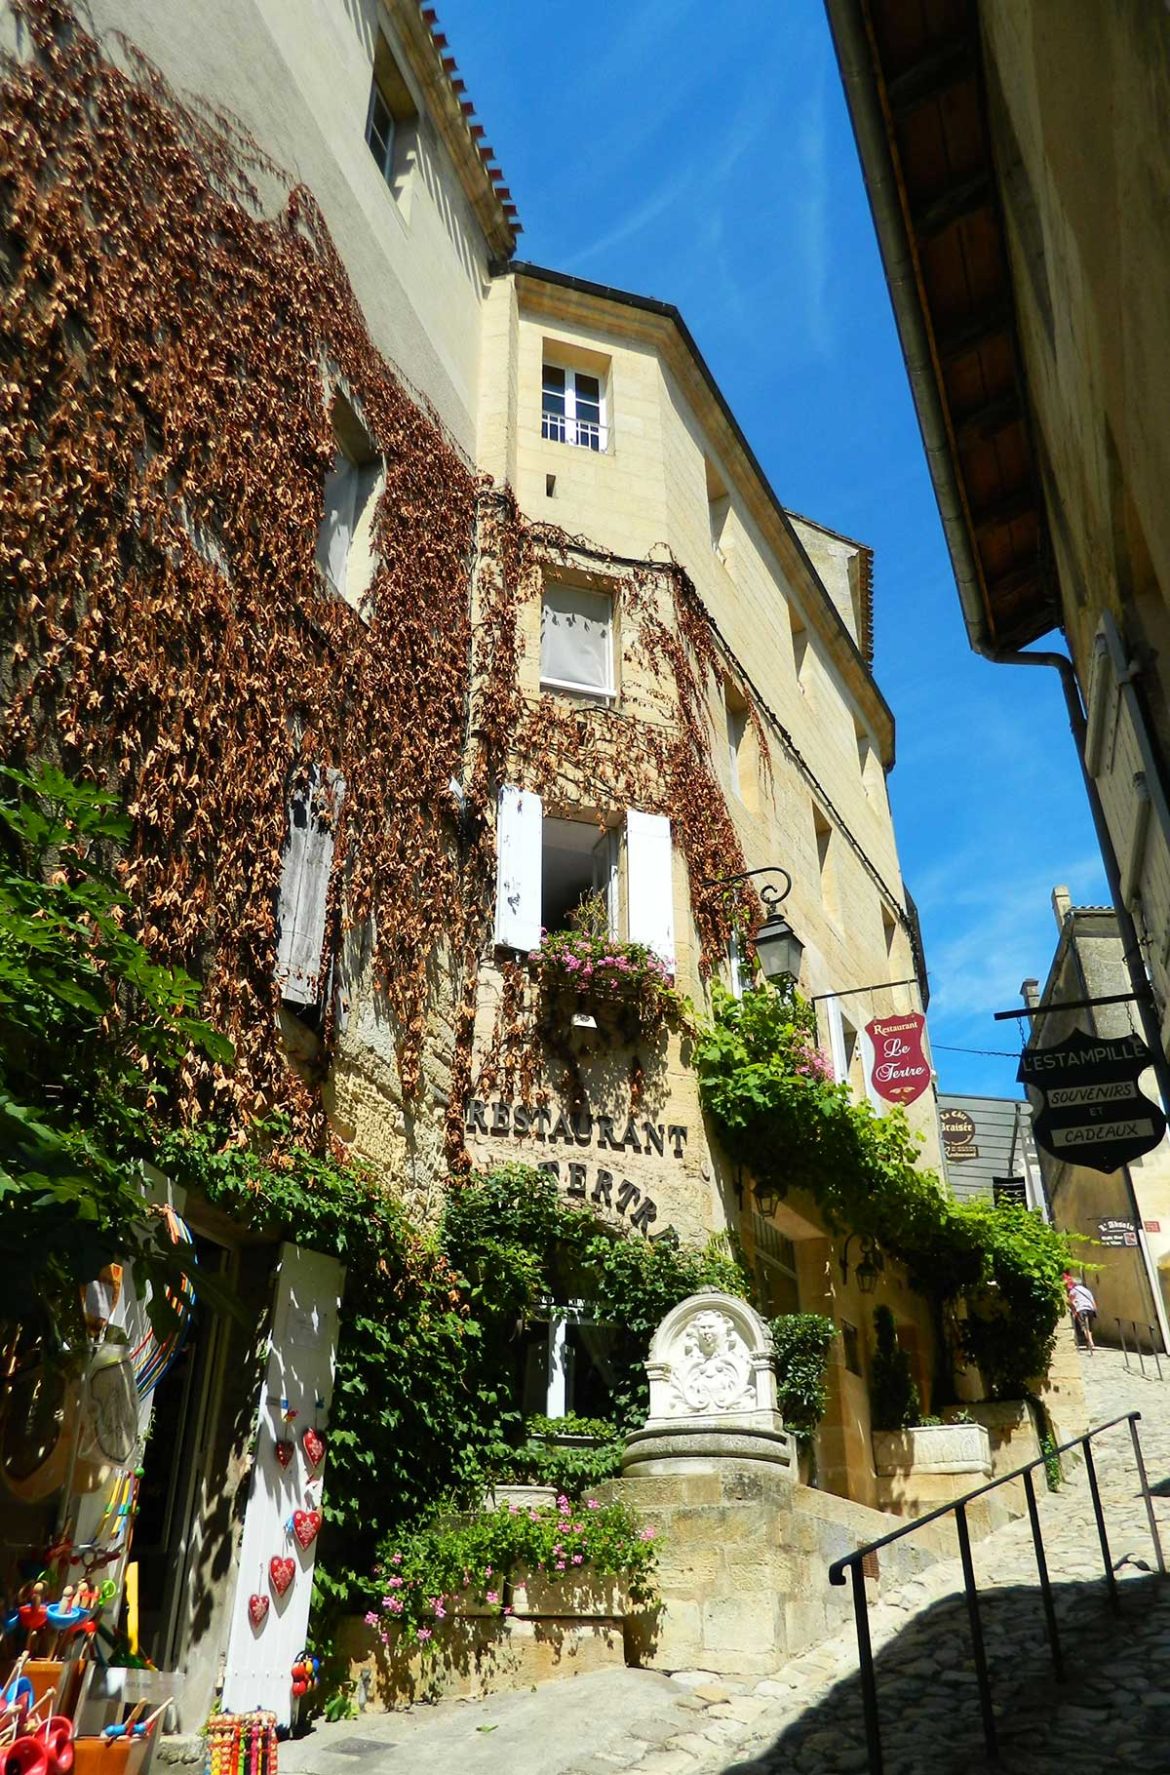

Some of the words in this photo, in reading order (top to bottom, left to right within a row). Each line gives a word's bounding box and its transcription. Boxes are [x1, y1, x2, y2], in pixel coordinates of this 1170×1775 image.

[873, 1021, 918, 1037] Restaurant
[883, 1038, 910, 1058] Le
[1022, 1043, 1146, 1072] L'ESTAMPILLE
[875, 1062, 925, 1082] Tertre
[1051, 1083, 1133, 1104] SOUVENIRS
[1089, 1106, 1104, 1117] ET
[466, 1099, 688, 1158] RESTAURANT
[1064, 1123, 1139, 1143] CADEAUX
